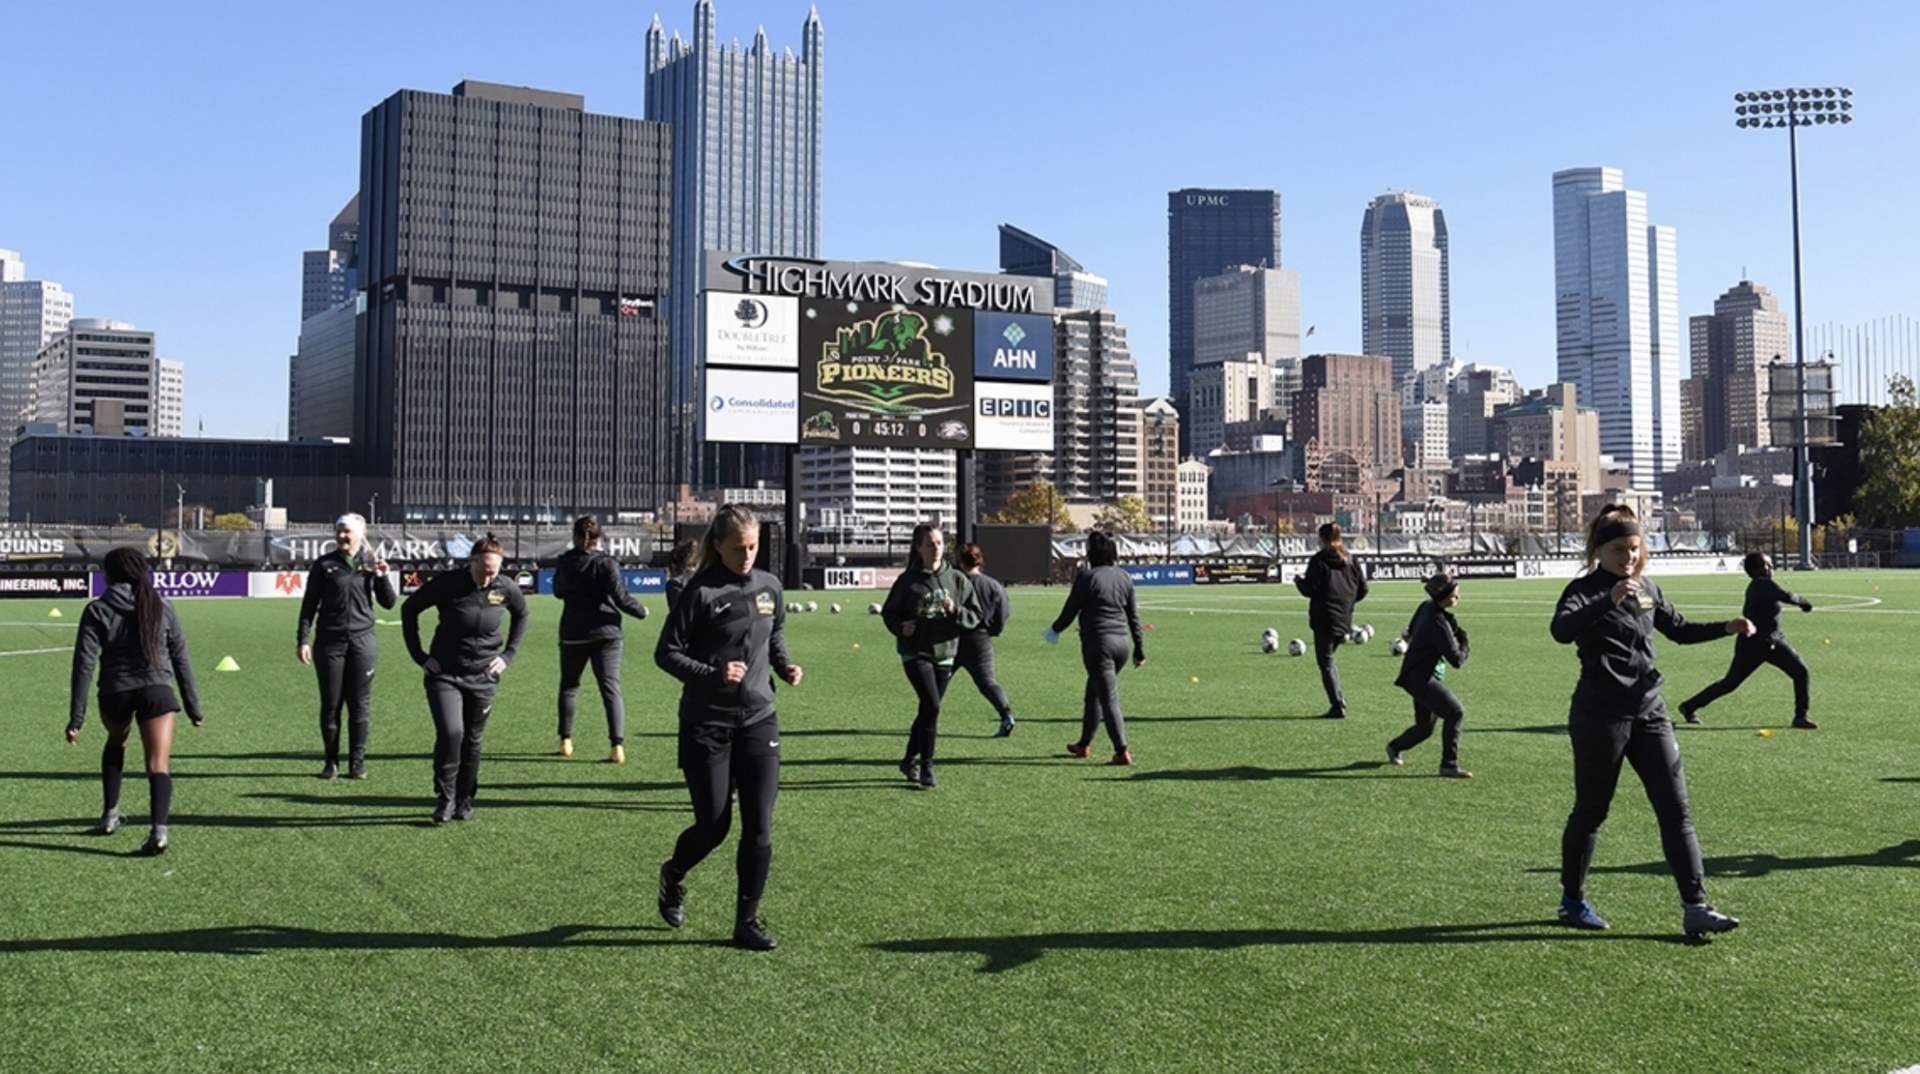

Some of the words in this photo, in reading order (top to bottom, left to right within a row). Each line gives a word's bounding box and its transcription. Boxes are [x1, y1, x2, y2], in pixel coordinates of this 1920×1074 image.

[1186, 195, 1229, 206] UPMC
[749, 259, 907, 302] HIGHMARK
[920, 277, 1035, 309] STADIUM
[851, 355, 880, 364] POINT
[896, 357, 921, 366] PARK
[993, 348, 1036, 370] AHN
[821, 362, 949, 390] PIONEERS
[728, 397, 796, 409] Consolidated
[982, 399, 1049, 417] EPIC
[853, 422, 861, 435] 0
[873, 422, 905, 436] 45:12
[918, 424, 926, 437] 0
[290, 540, 439, 560] HIGMARK
[1371, 563, 1394, 579] JACK
[63, 578, 88, 590] INC.
[152, 571, 220, 589] RLOW
[642, 577, 661, 586] AHN
